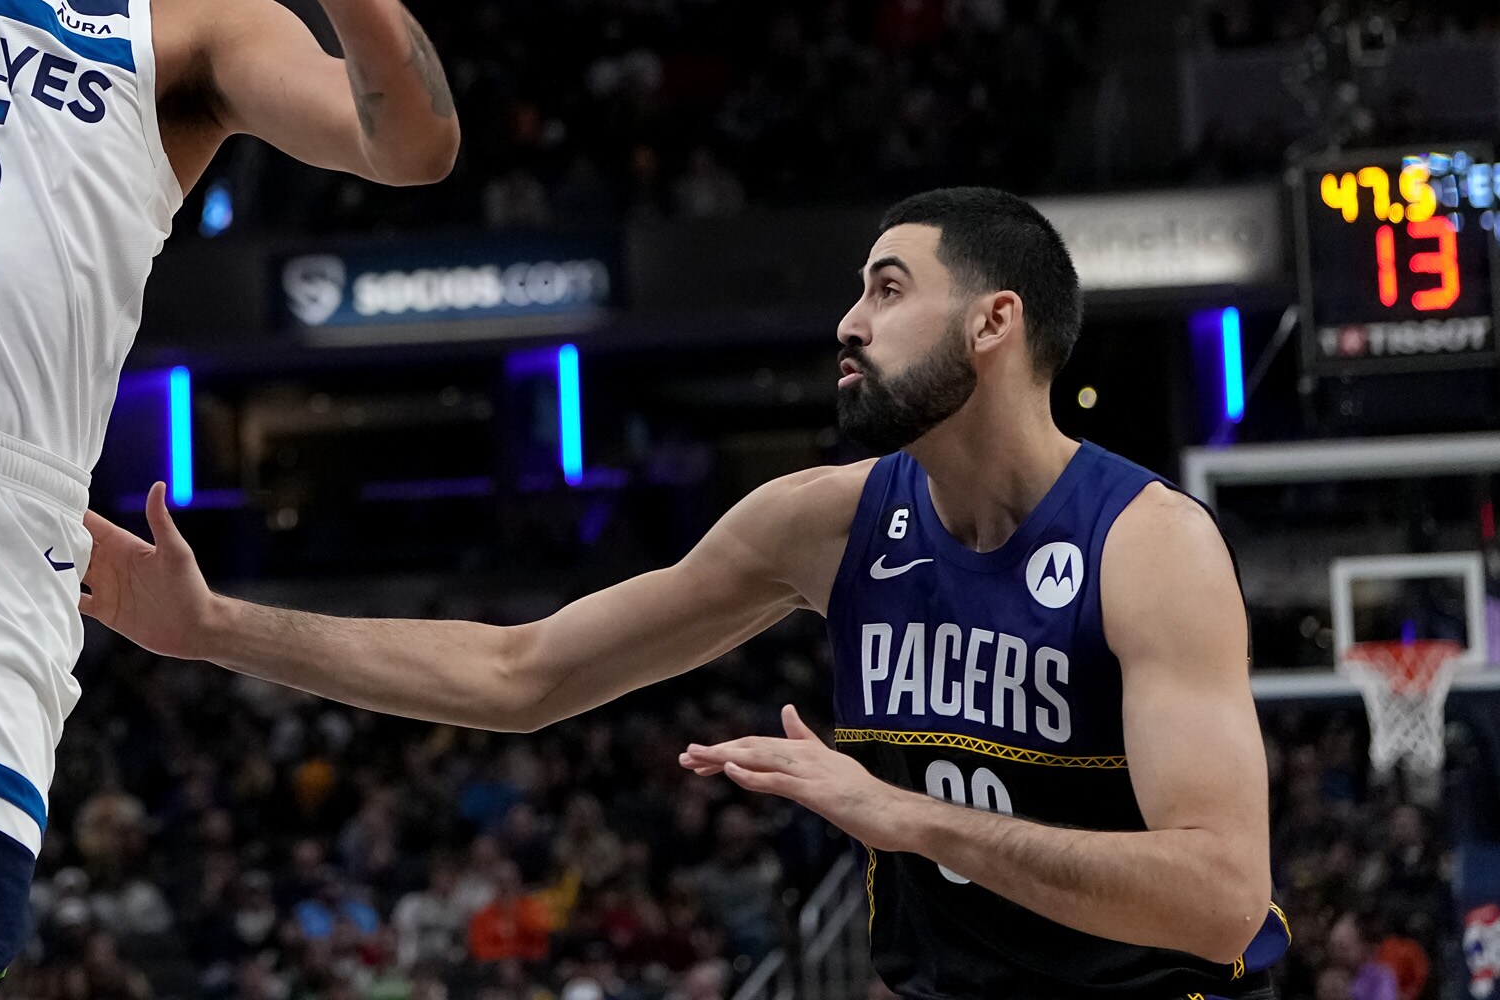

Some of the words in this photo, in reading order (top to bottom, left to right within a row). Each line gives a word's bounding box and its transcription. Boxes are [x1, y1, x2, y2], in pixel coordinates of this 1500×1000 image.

[1320, 164, 1437, 224] 47.5
[1374, 215, 1461, 311] 13
[886, 508, 909, 540] 6
[861, 622, 1073, 744] PACERS
